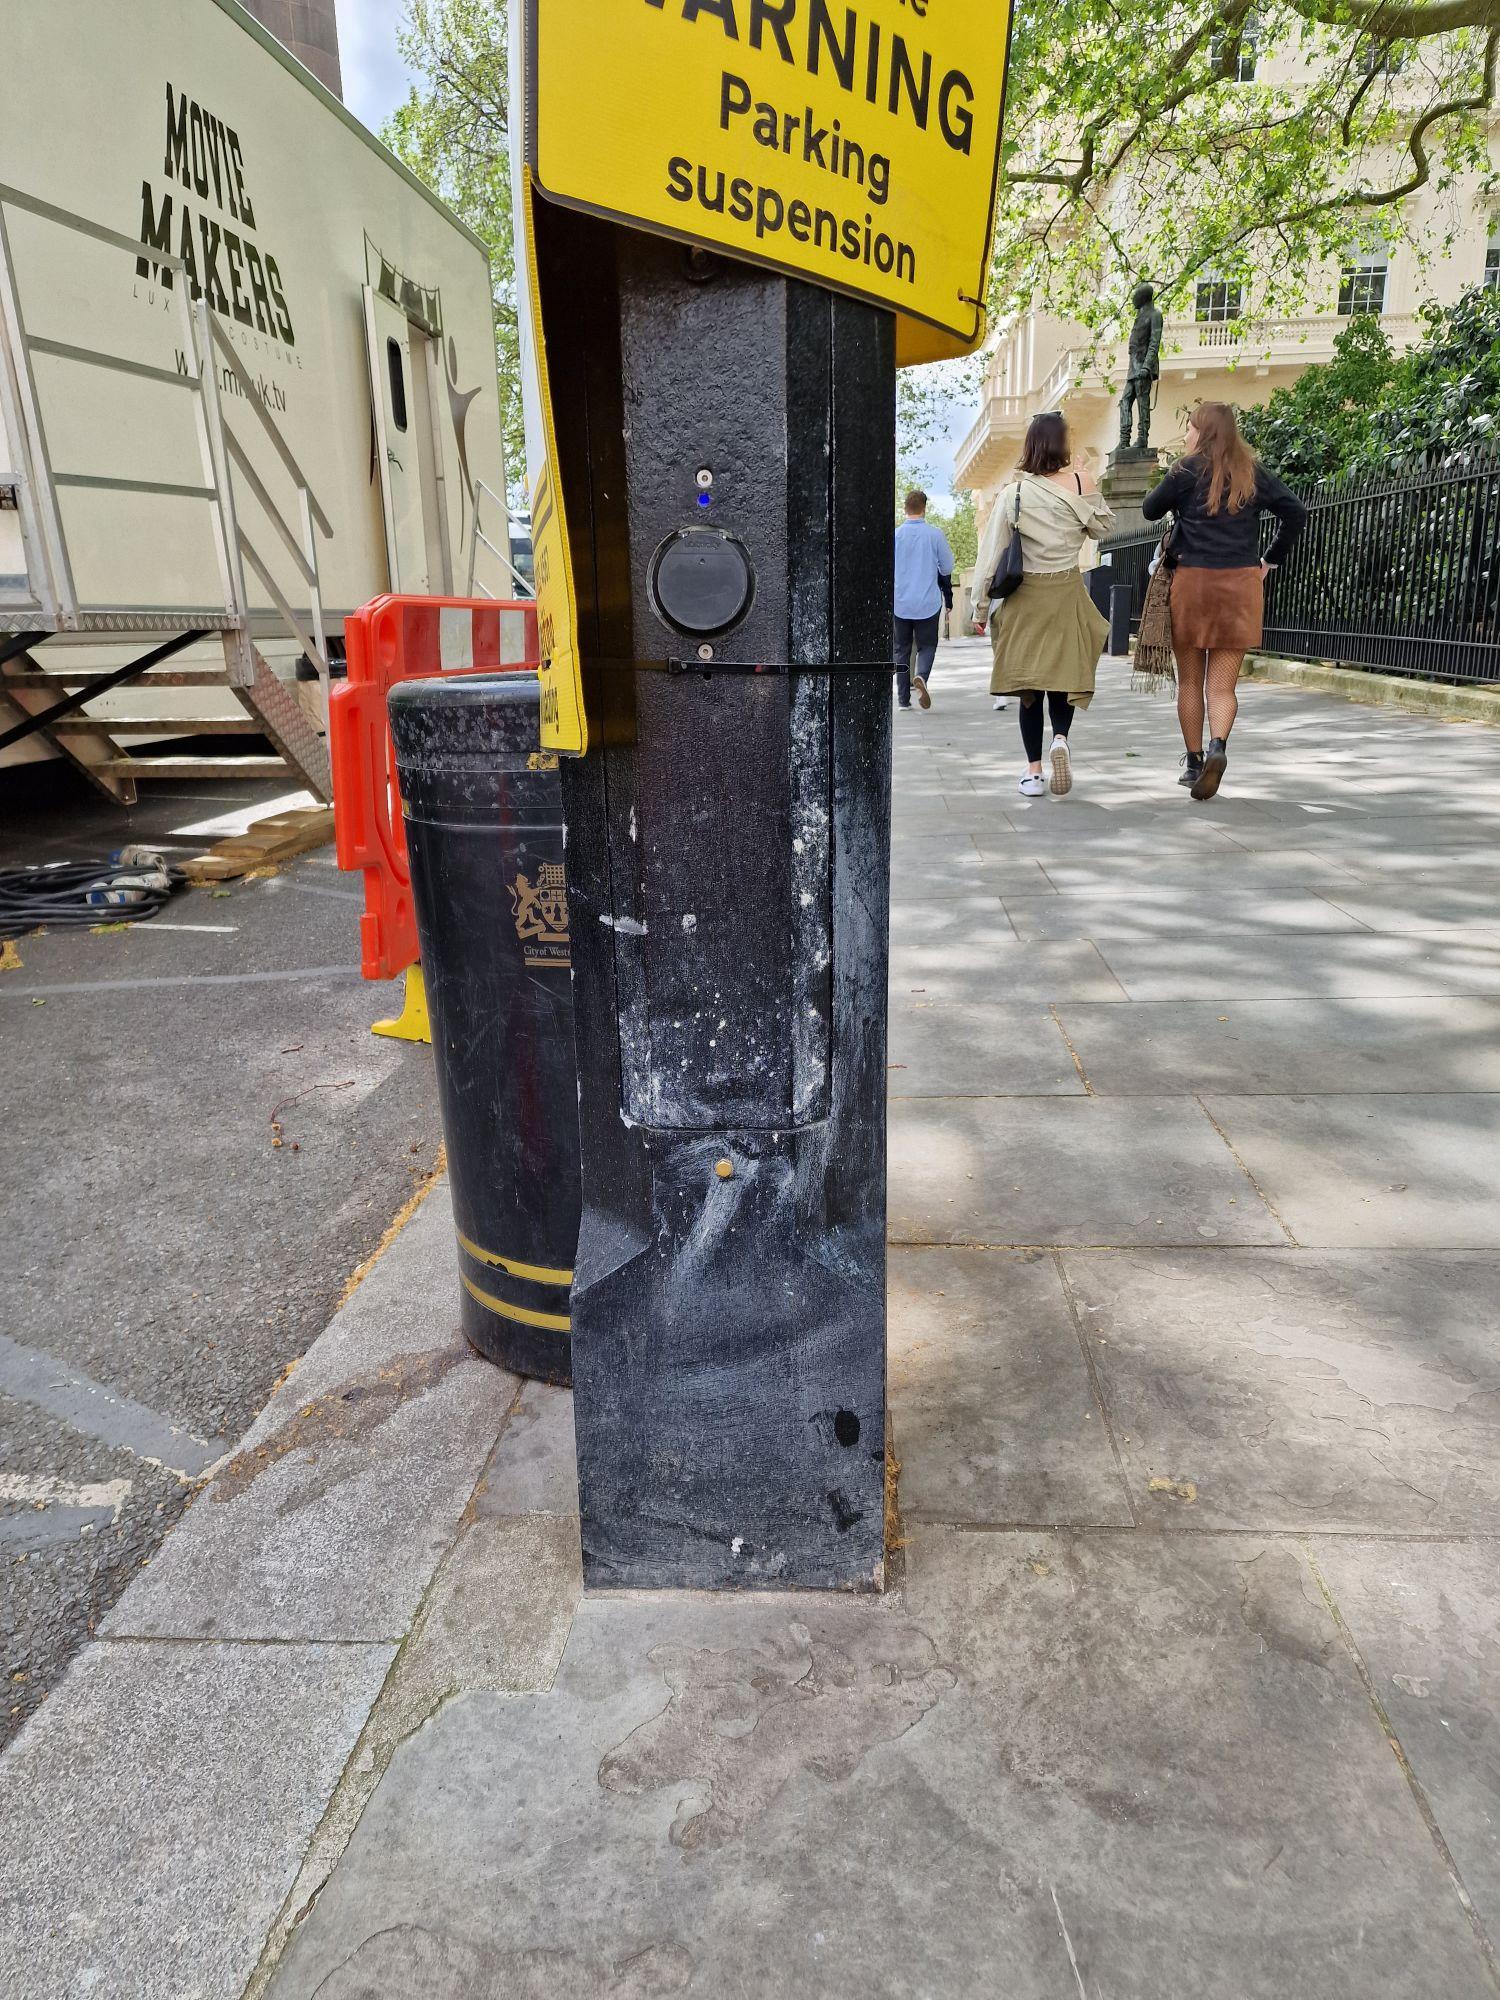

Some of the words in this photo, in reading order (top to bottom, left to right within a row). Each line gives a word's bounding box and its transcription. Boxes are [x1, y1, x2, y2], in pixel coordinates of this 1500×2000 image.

[645, 0, 975, 156] RNING
[719, 71, 891, 205] Parking
[164, 81, 257, 231] MOVIE
[666, 156, 917, 285] suspension
[135, 180, 295, 348] MAKERS
[523, 945, 539, 958] City
[539, 946, 549, 956] of
